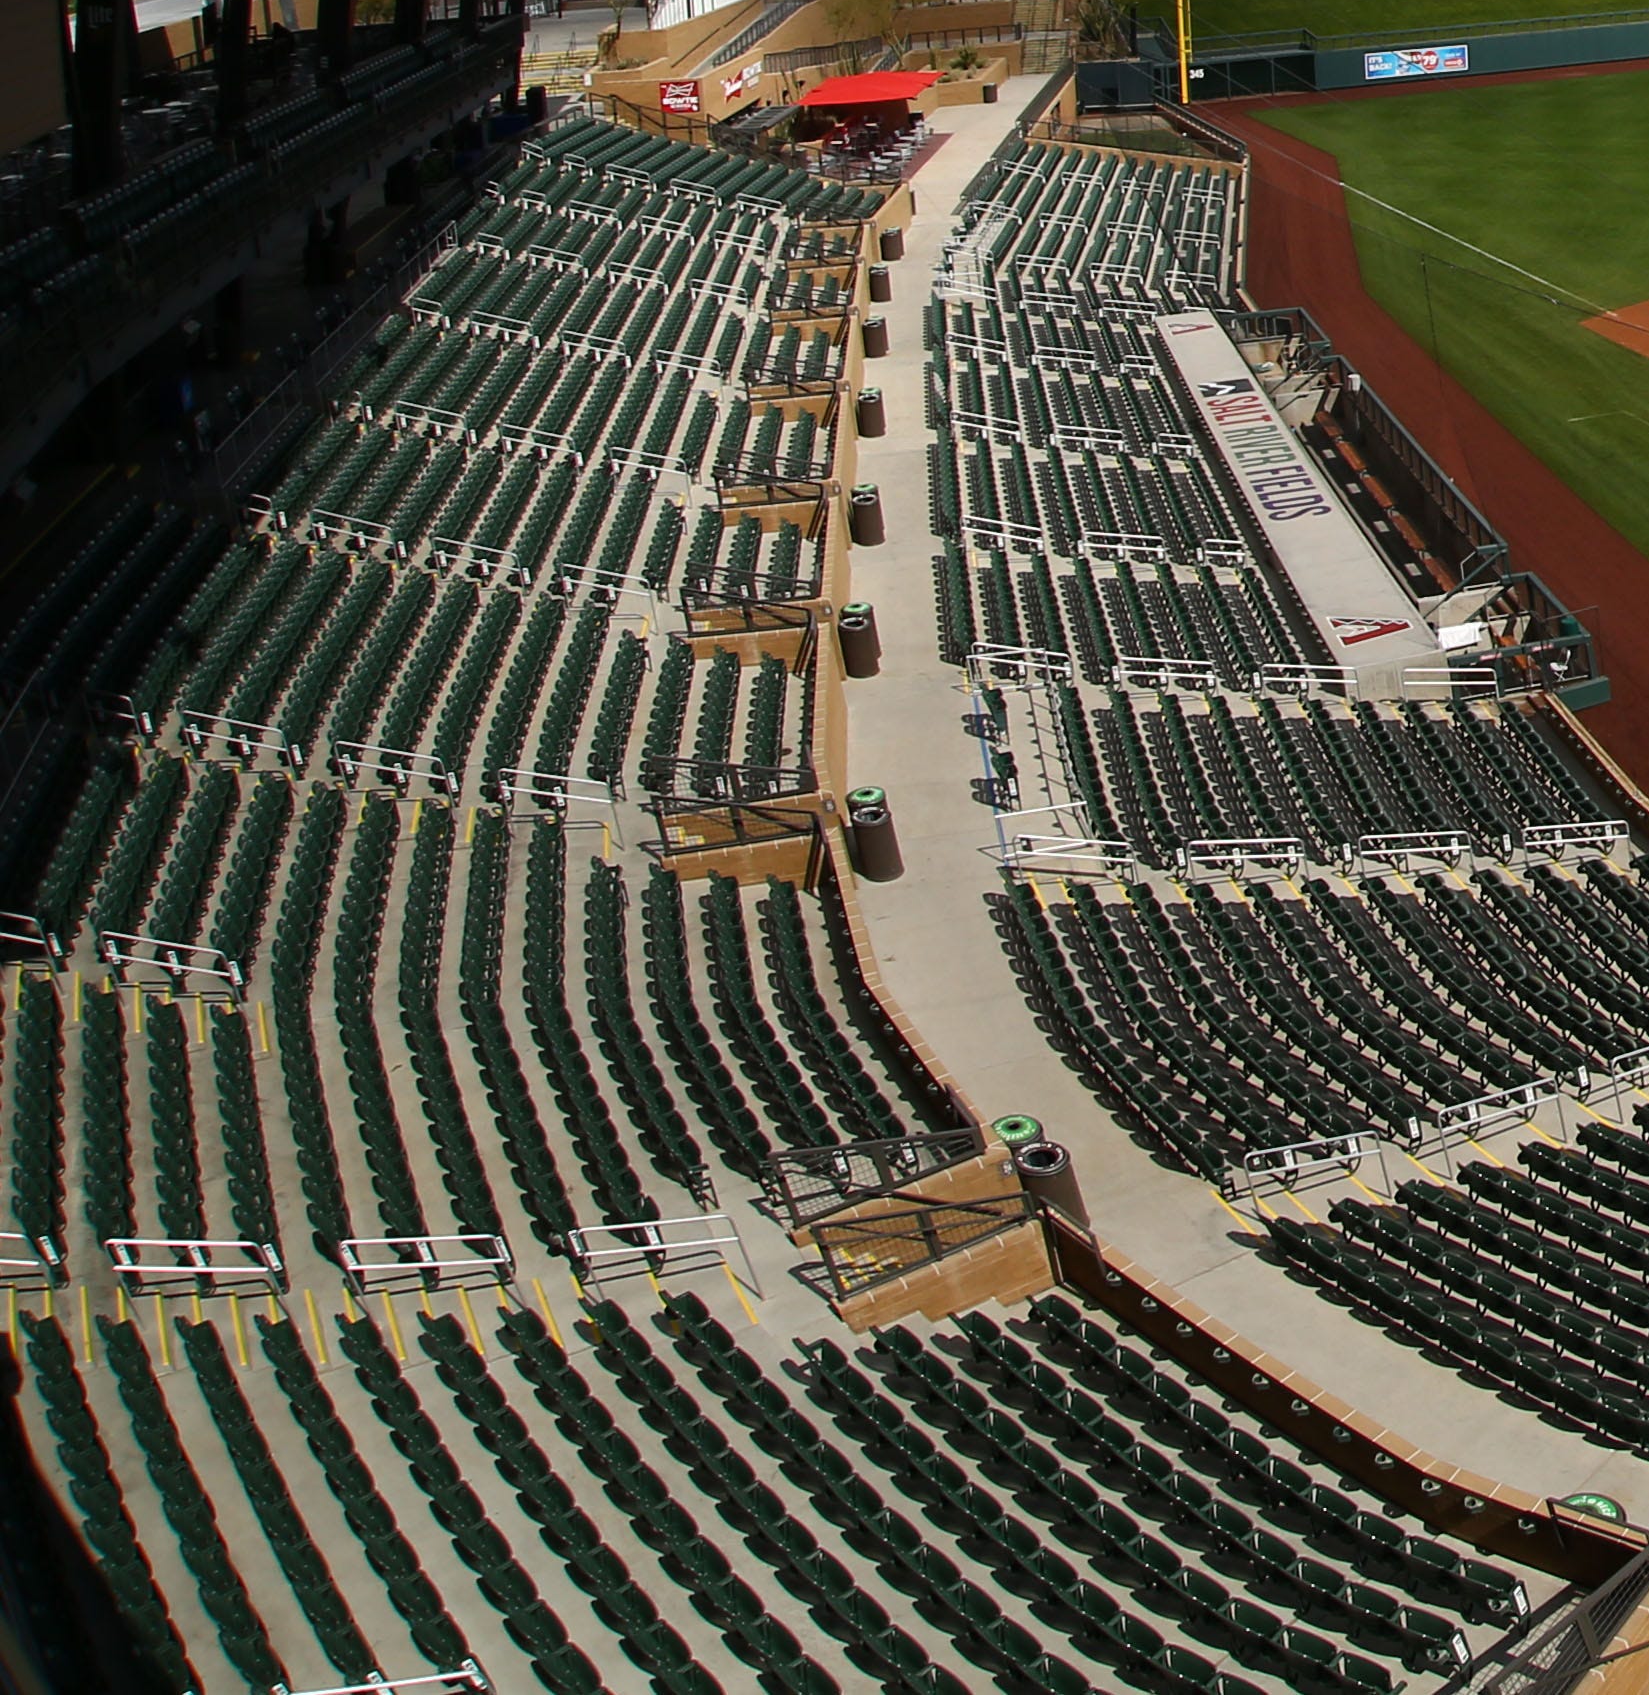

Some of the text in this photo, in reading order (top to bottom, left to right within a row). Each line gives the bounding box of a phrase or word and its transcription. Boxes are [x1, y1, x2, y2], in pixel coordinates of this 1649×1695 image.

[662, 96, 698, 105] BOWTIE
[1207, 395, 1332, 521] SALT RIVER FIELDS
